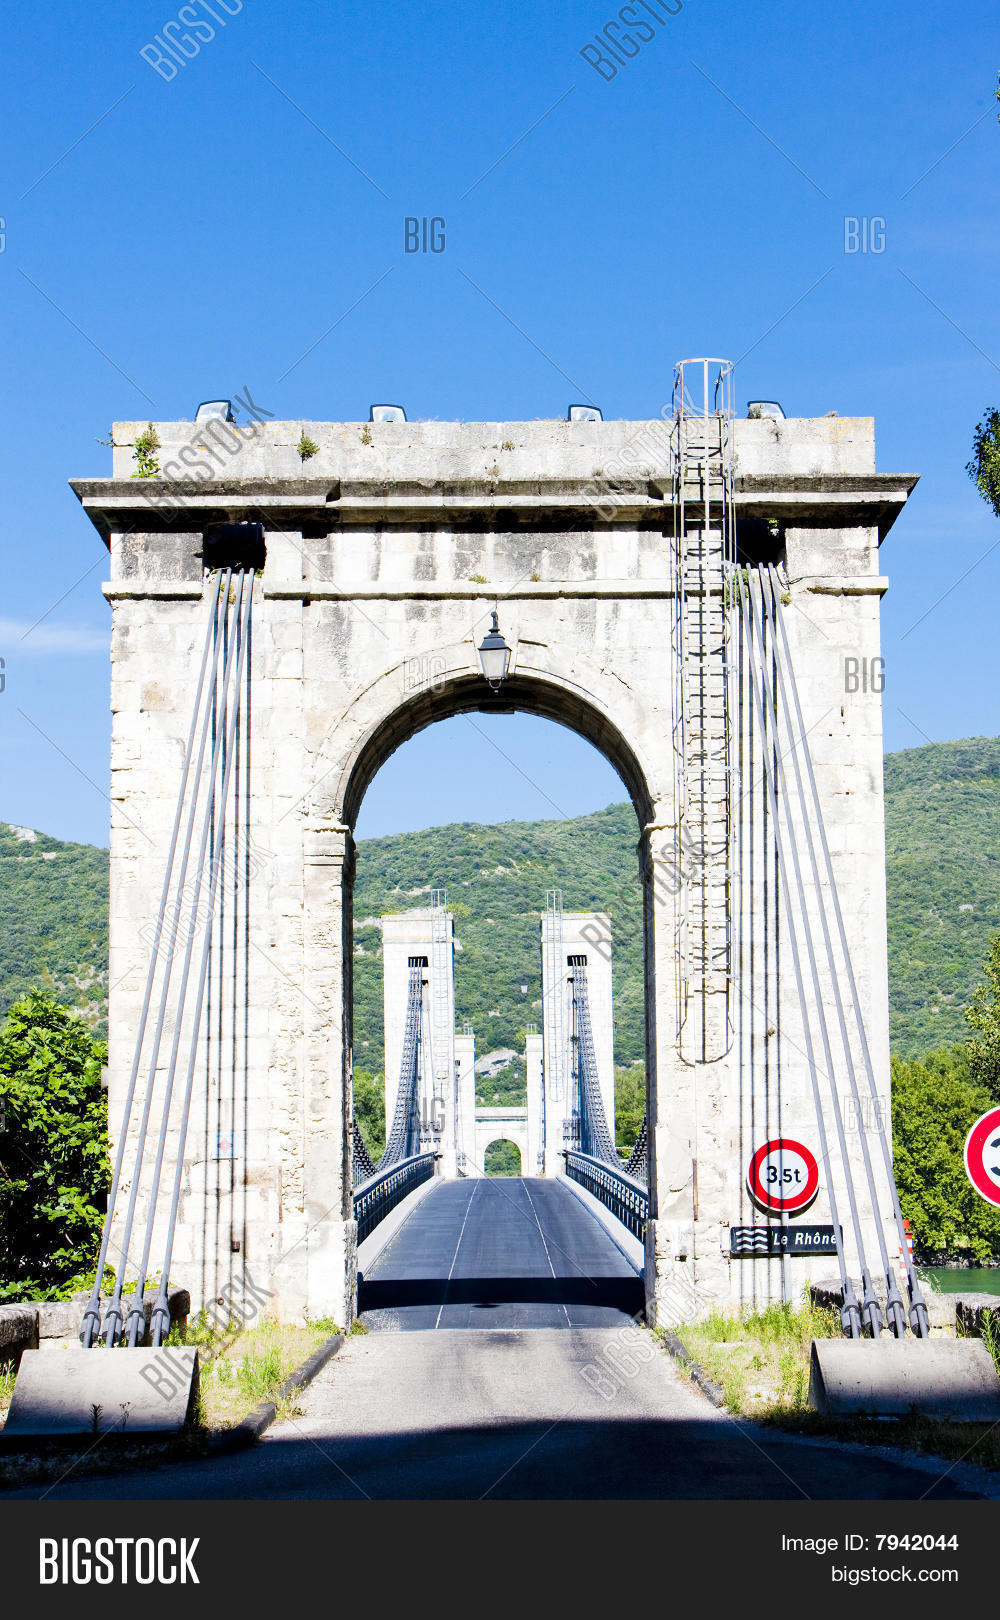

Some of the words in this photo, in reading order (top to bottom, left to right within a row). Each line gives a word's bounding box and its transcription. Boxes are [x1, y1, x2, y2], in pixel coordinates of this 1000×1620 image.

[766, 1165, 802, 1187] 3,5t
[773, 1232, 788, 1246] Le
[794, 1231, 838, 1246] Rhône
